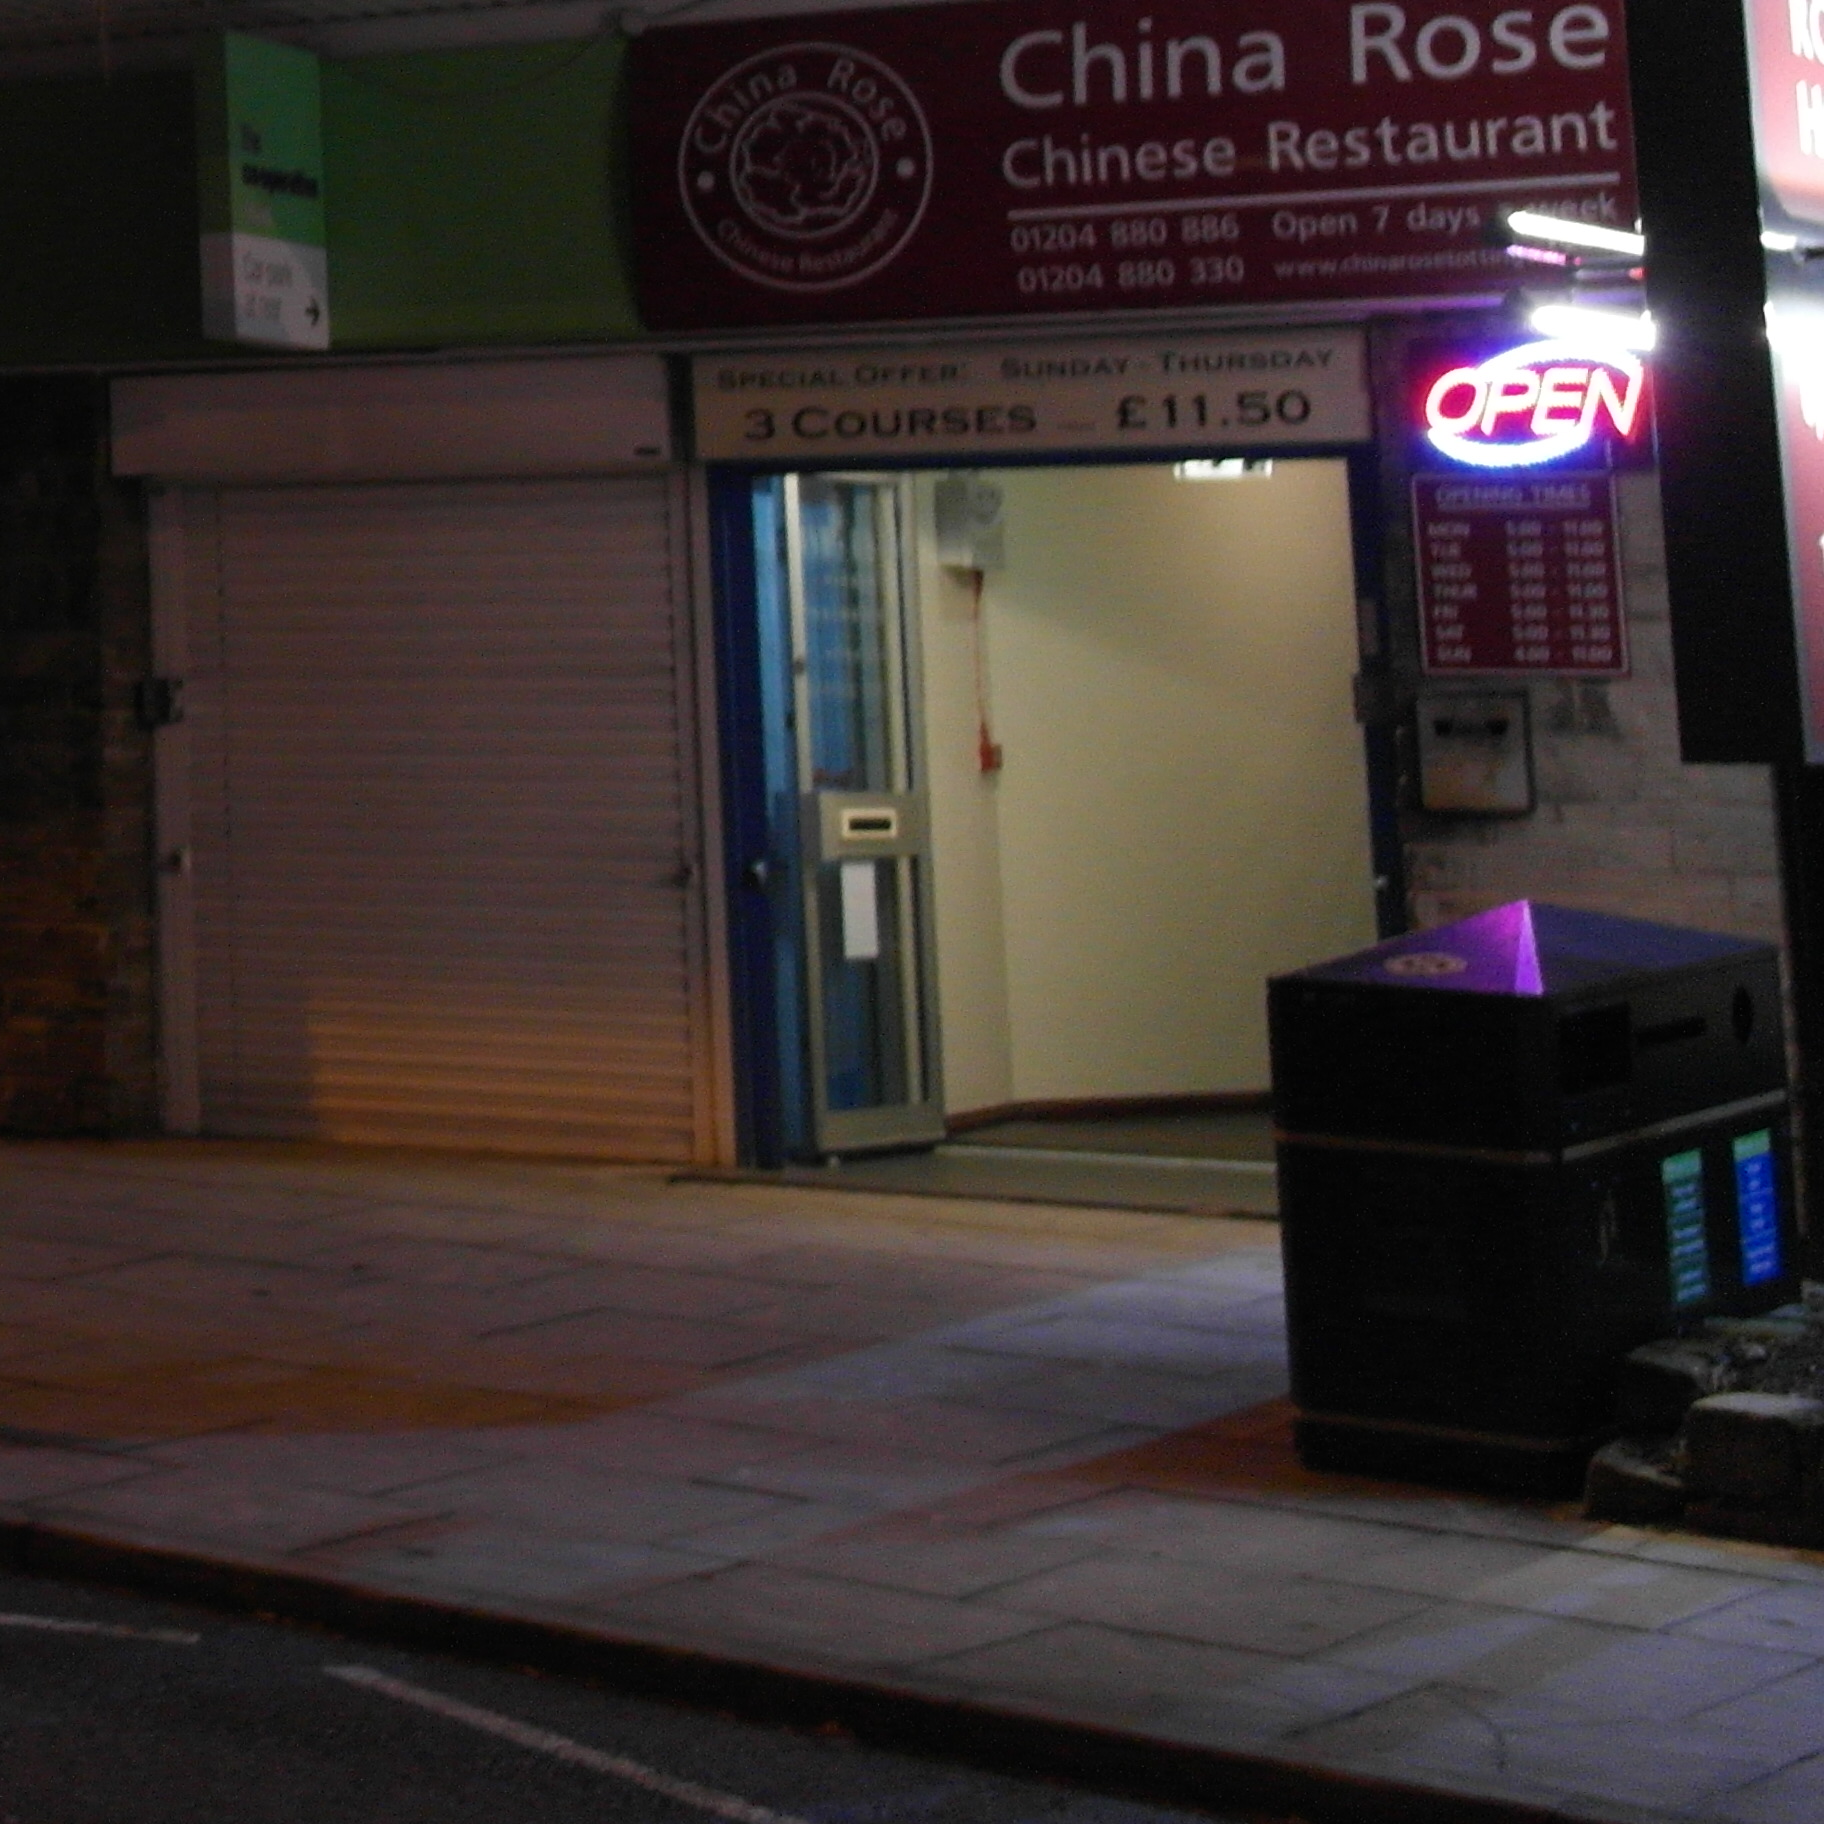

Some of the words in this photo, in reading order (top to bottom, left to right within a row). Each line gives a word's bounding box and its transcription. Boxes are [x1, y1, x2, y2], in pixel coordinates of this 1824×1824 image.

[999, 16, 1286, 110] China
[1350, 1, 1610, 85] Rose
[695, 63, 798, 154] China
[826, 56, 908, 142] Rose
[1001, 131, 1237, 188] Chinese
[1265, 100, 1619, 172] Restaurant
[1009, 222, 1098, 254] 01204
[1109, 217, 1168, 249] 880
[1272, 209, 1359, 243] Open
[1370, 205, 1392, 234] 7
[1406, 200, 1481, 235] days
[1016, 262, 1104, 294] 01204
[1117, 257, 1176, 289] 880
[1189, 254, 1245, 286] 330
[716, 366, 846, 392] SPECIAL
[1000, 356, 1131, 382] SUNDAY
[1159, 348, 1334, 374] THURSDAY
[1425, 365, 1645, 439] OPEN
[743, 407, 776, 441] 3
[791, 404, 1038, 440] COURSES
[1115, 388, 1313, 429] £11.50
